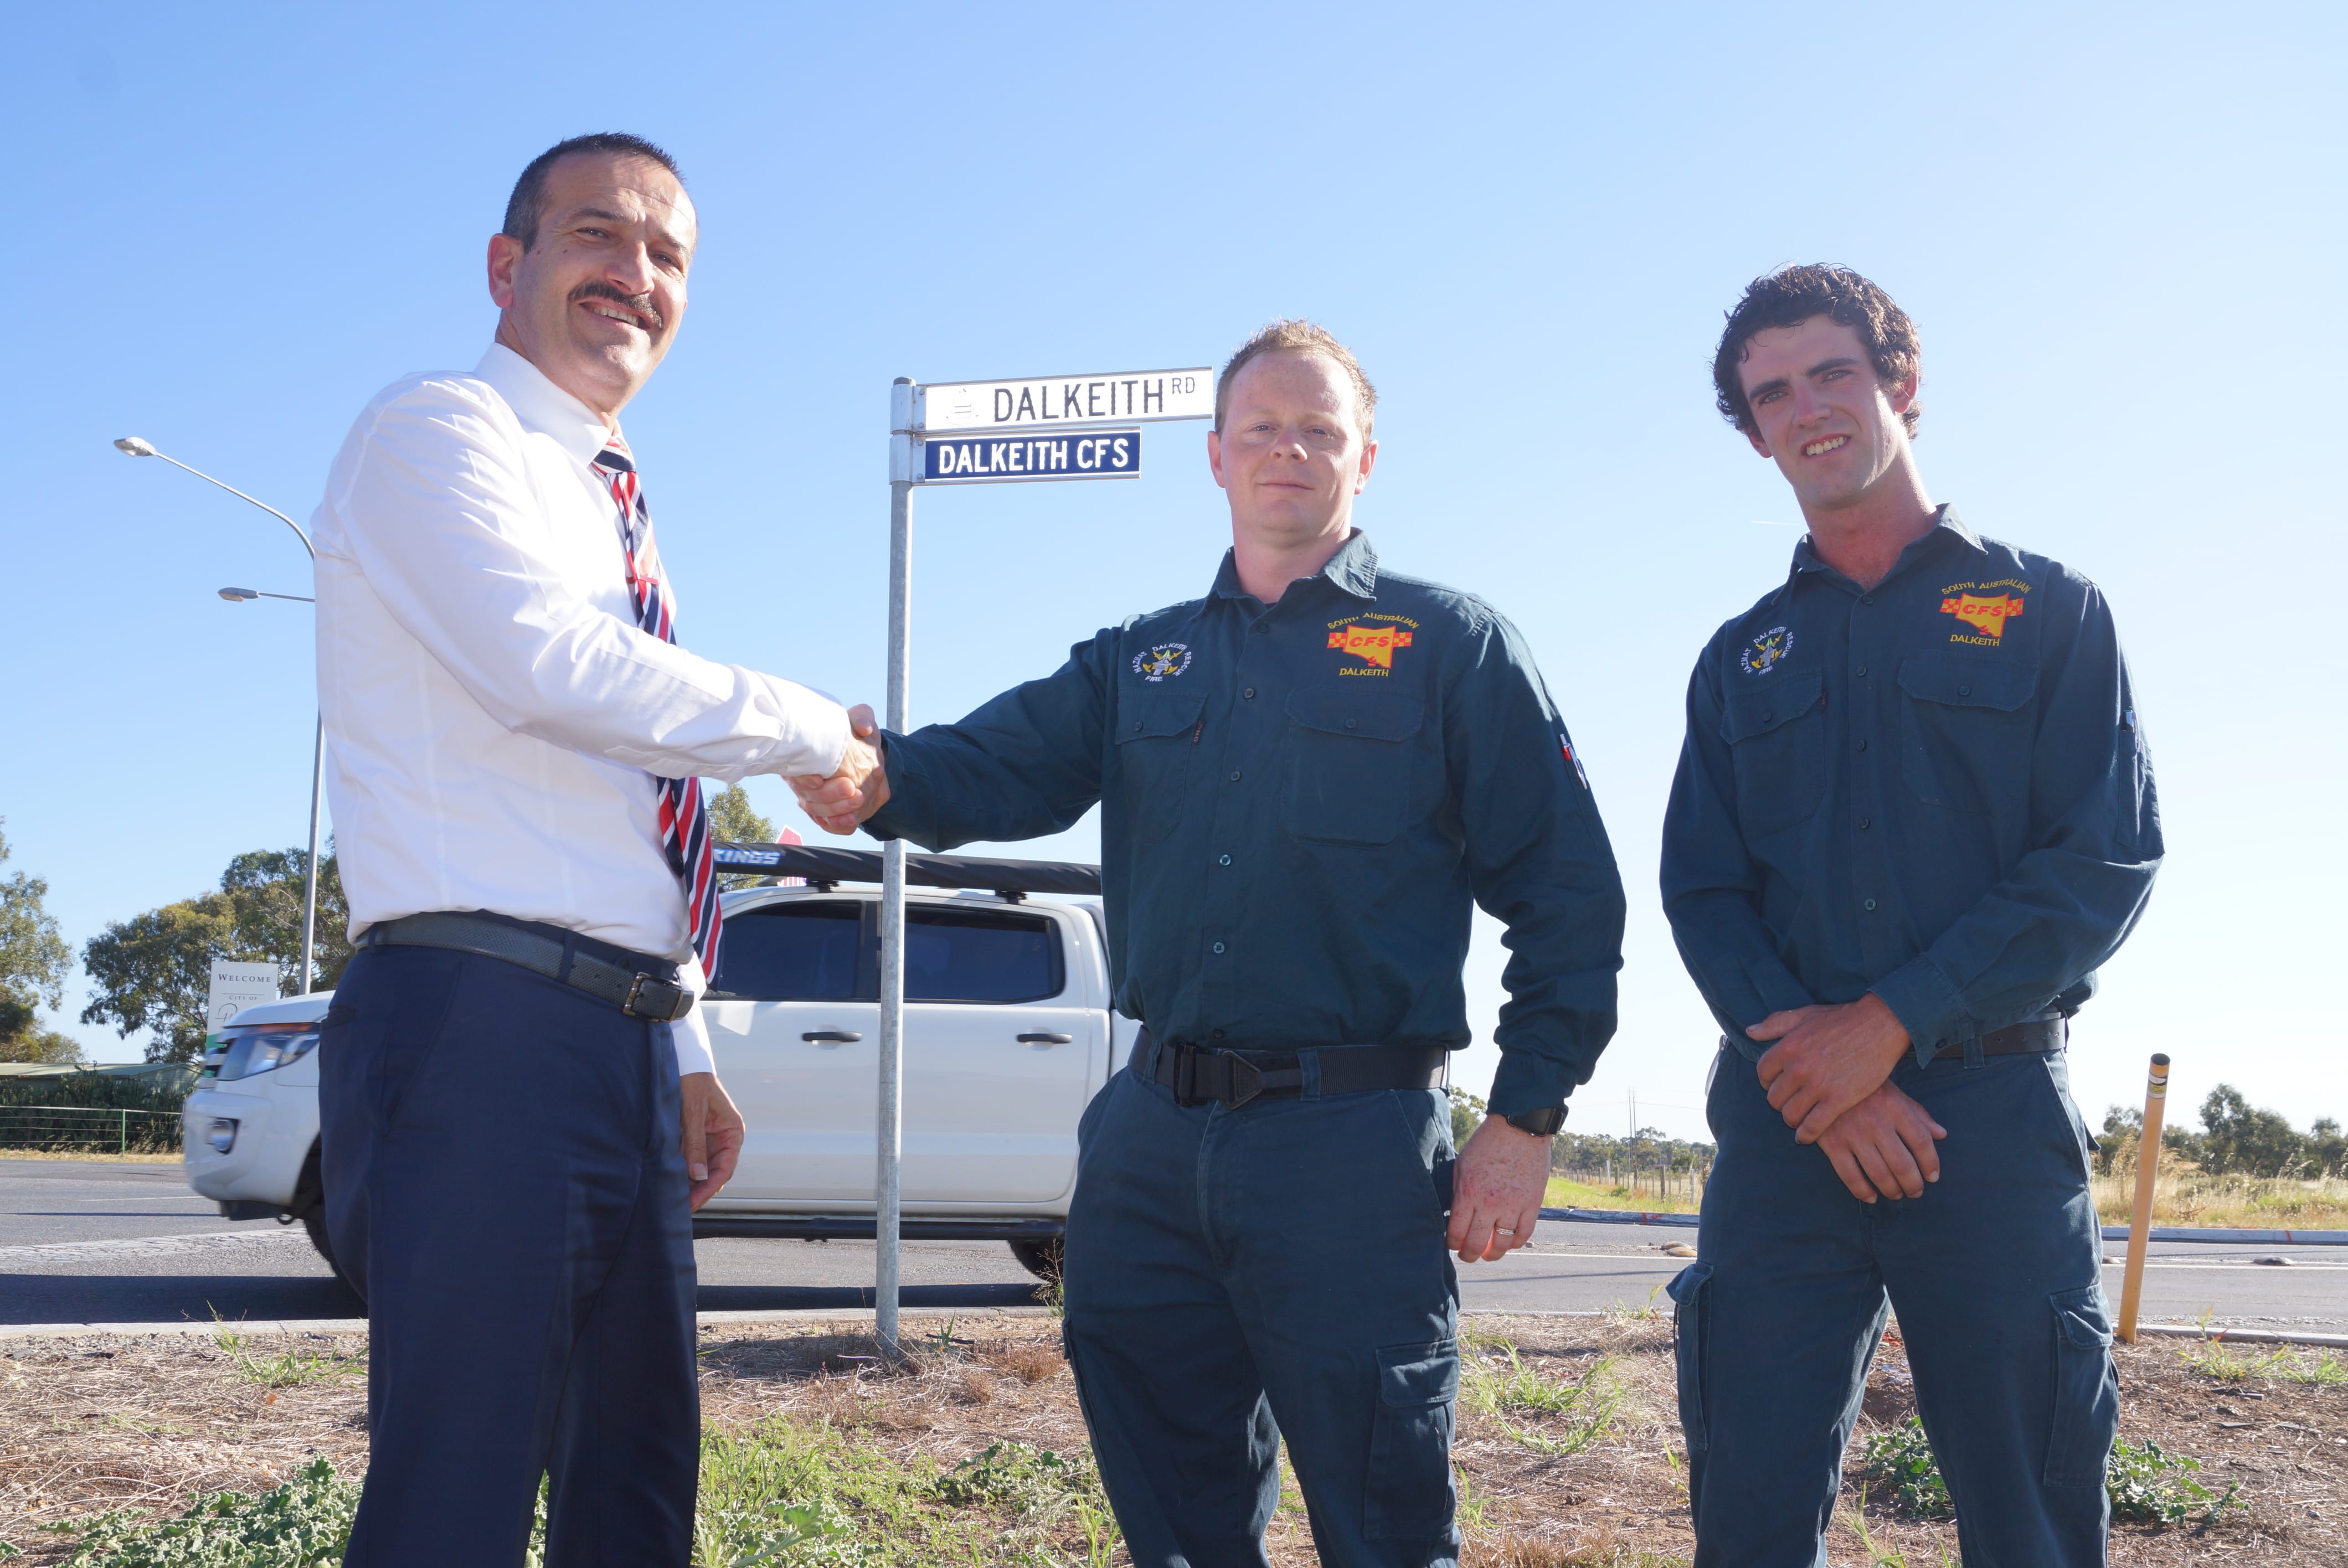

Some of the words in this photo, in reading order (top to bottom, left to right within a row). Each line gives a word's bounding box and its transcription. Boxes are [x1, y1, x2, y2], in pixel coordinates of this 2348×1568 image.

[994, 379, 1163, 422] DALKEITH
[1171, 377, 1196, 395] RD
[939, 441, 1068, 474] DALKEITH
[1077, 438, 1129, 468] CFS
[1942, 582, 1975, 595] SOUTH
[1979, 578, 2032, 594] AUSTRALIAN
[1962, 604, 2003, 617] CFS
[1327, 616, 1360, 630] SOUTH
[1363, 612, 1420, 630] AUSTRALIAN
[1349, 636, 1391, 647] CFS
[1753, 626, 1786, 644] DALKEITH
[1950, 634, 2001, 647] DALKEITH
[1152, 642, 1188, 651] DALKEITH
[1779, 632, 1794, 659] RESCUE
[1132, 651, 1147, 674] HAZMAT
[1172, 651, 1192, 677] RESCUE
[1741, 648, 1754, 674] HAZMAT
[1339, 668, 1389, 677] DALKEITH
[1758, 665, 1773, 676] FIRE
[713, 849, 781, 865] KINGS
[218, 973, 271, 983] WELCOME
